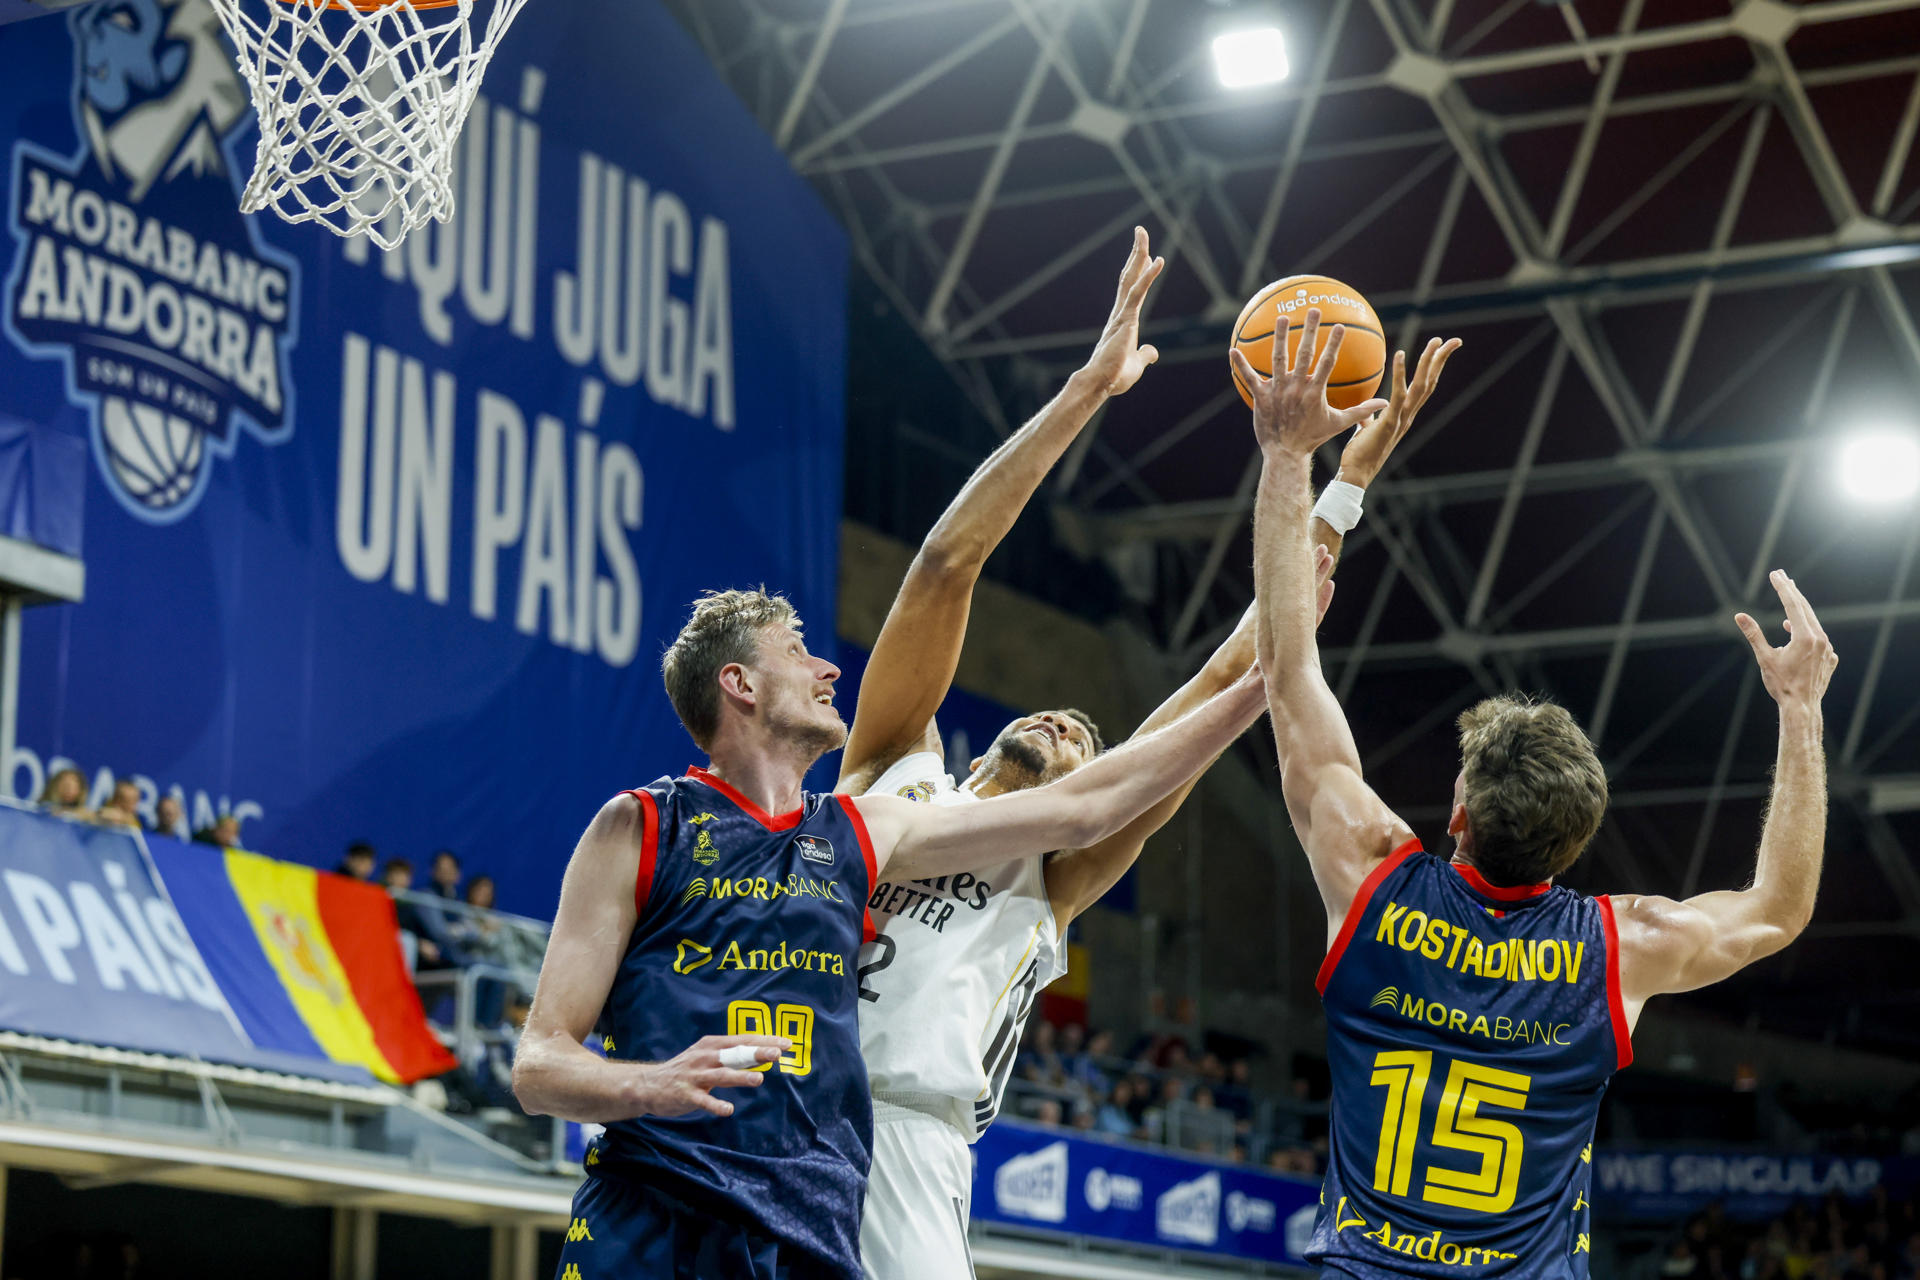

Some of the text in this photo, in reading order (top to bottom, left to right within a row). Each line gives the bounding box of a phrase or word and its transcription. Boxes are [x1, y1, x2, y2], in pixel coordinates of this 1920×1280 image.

[25, 169, 287, 322] MORABANC
[555, 153, 735, 431] JUGA
[1276, 290, 1308, 314] liga
[19, 236, 282, 414] ANDORRA
[337, 333, 644, 667] UN PAÍS
[4, 860, 224, 1011] PAÍS
[709, 873, 844, 903] MORABANC
[868, 882, 955, 933] BETTER
[1375, 901, 1584, 984] KOSTADINOV
[717, 940, 845, 976] Andorra
[1400, 993, 1571, 1045] MORABANC
[1369, 1050, 1532, 1213] 15
